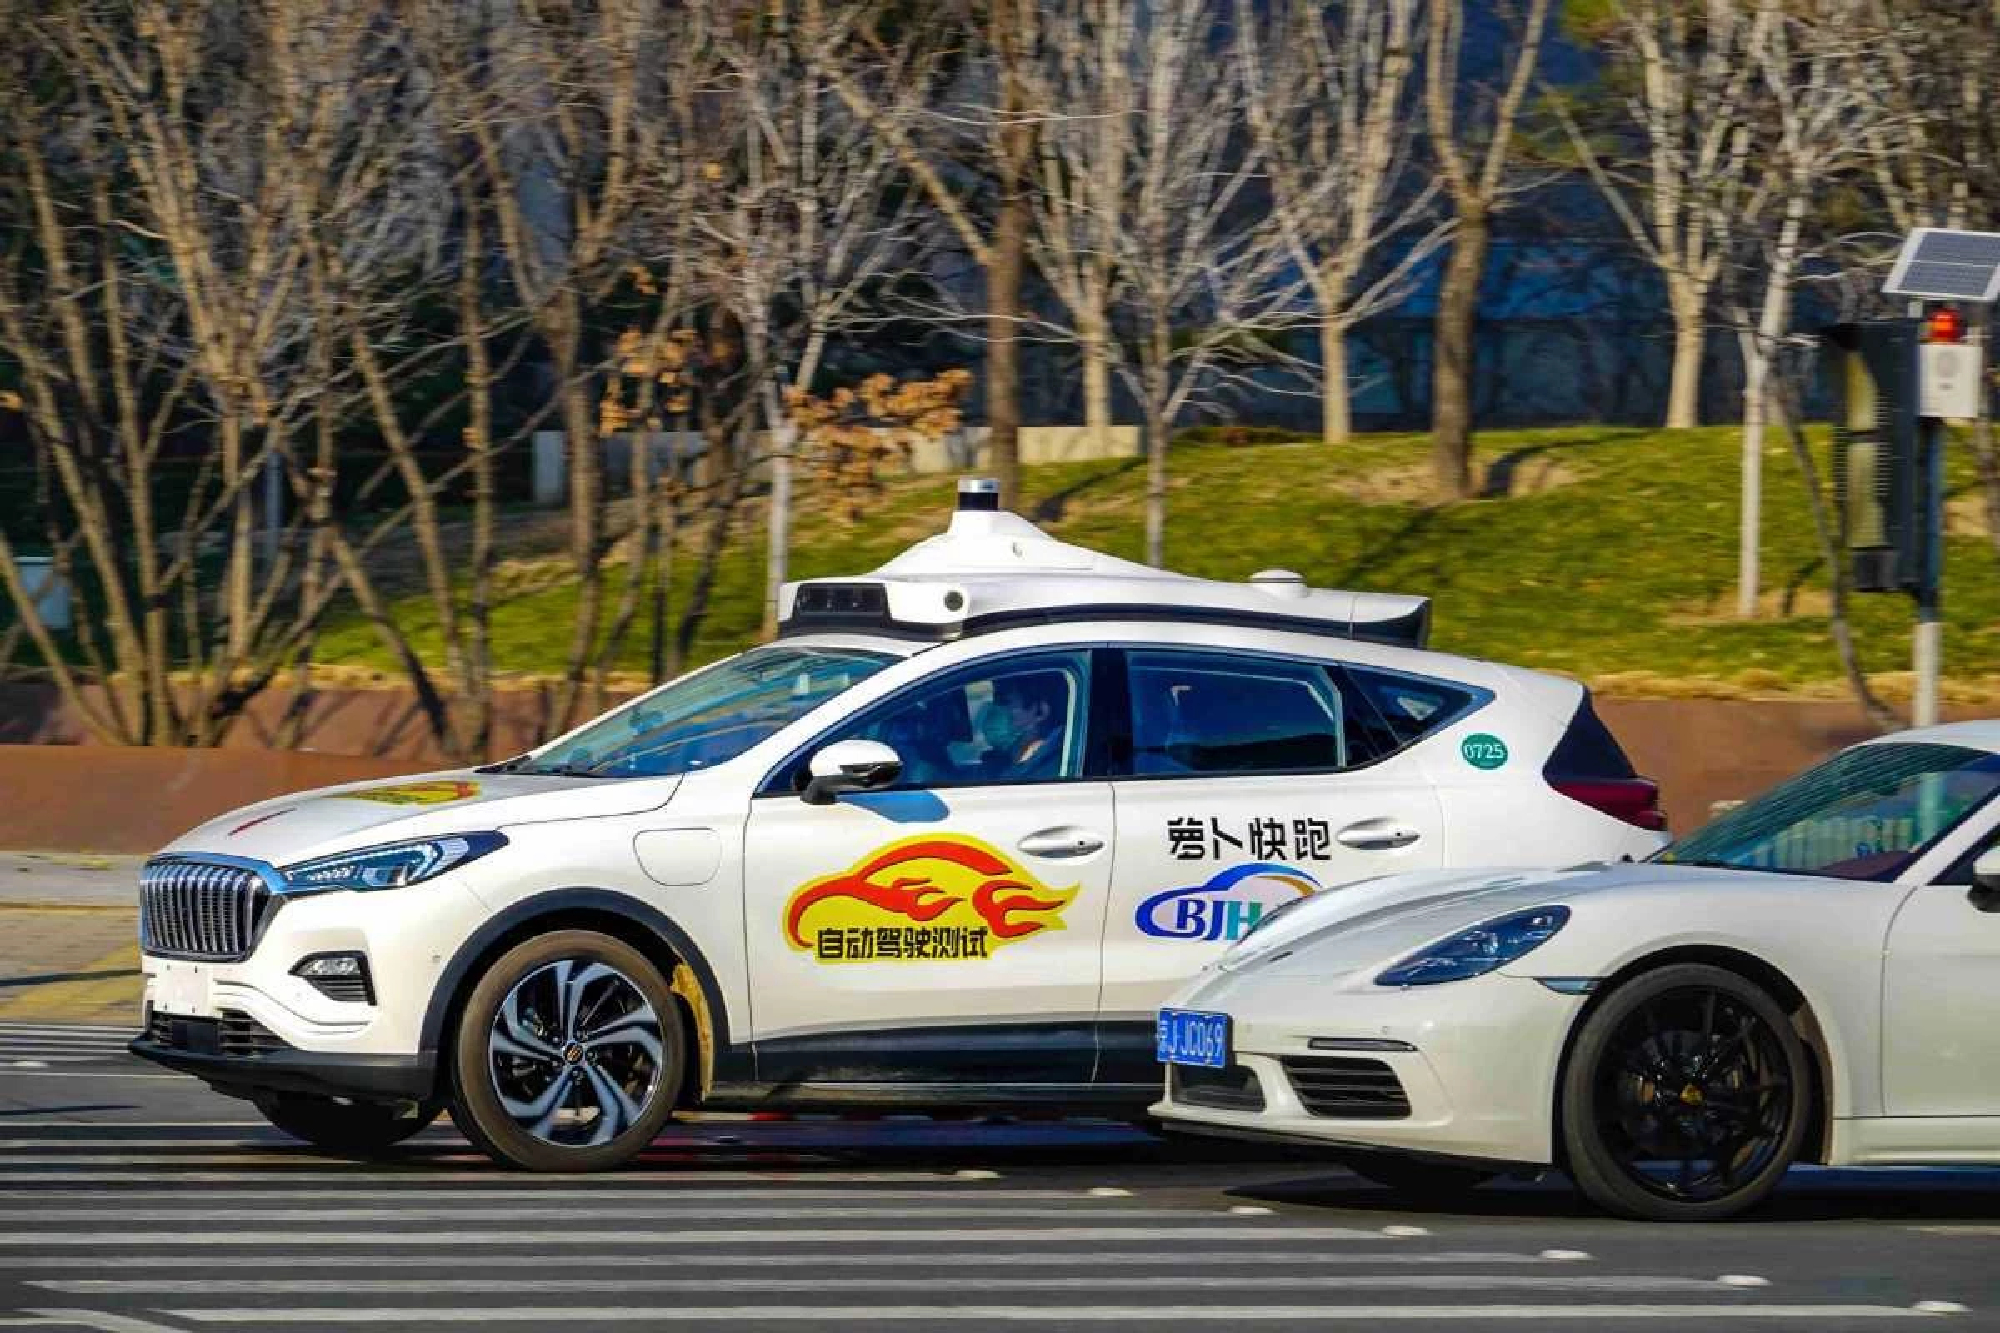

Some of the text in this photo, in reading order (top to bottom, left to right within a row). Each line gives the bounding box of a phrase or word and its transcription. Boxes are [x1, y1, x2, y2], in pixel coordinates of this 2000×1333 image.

[1464, 743, 1504, 759] 0725
[1167, 817, 1332, 860] 萝卜快跑
[817, 926, 988, 959] 自动驾驶测试
